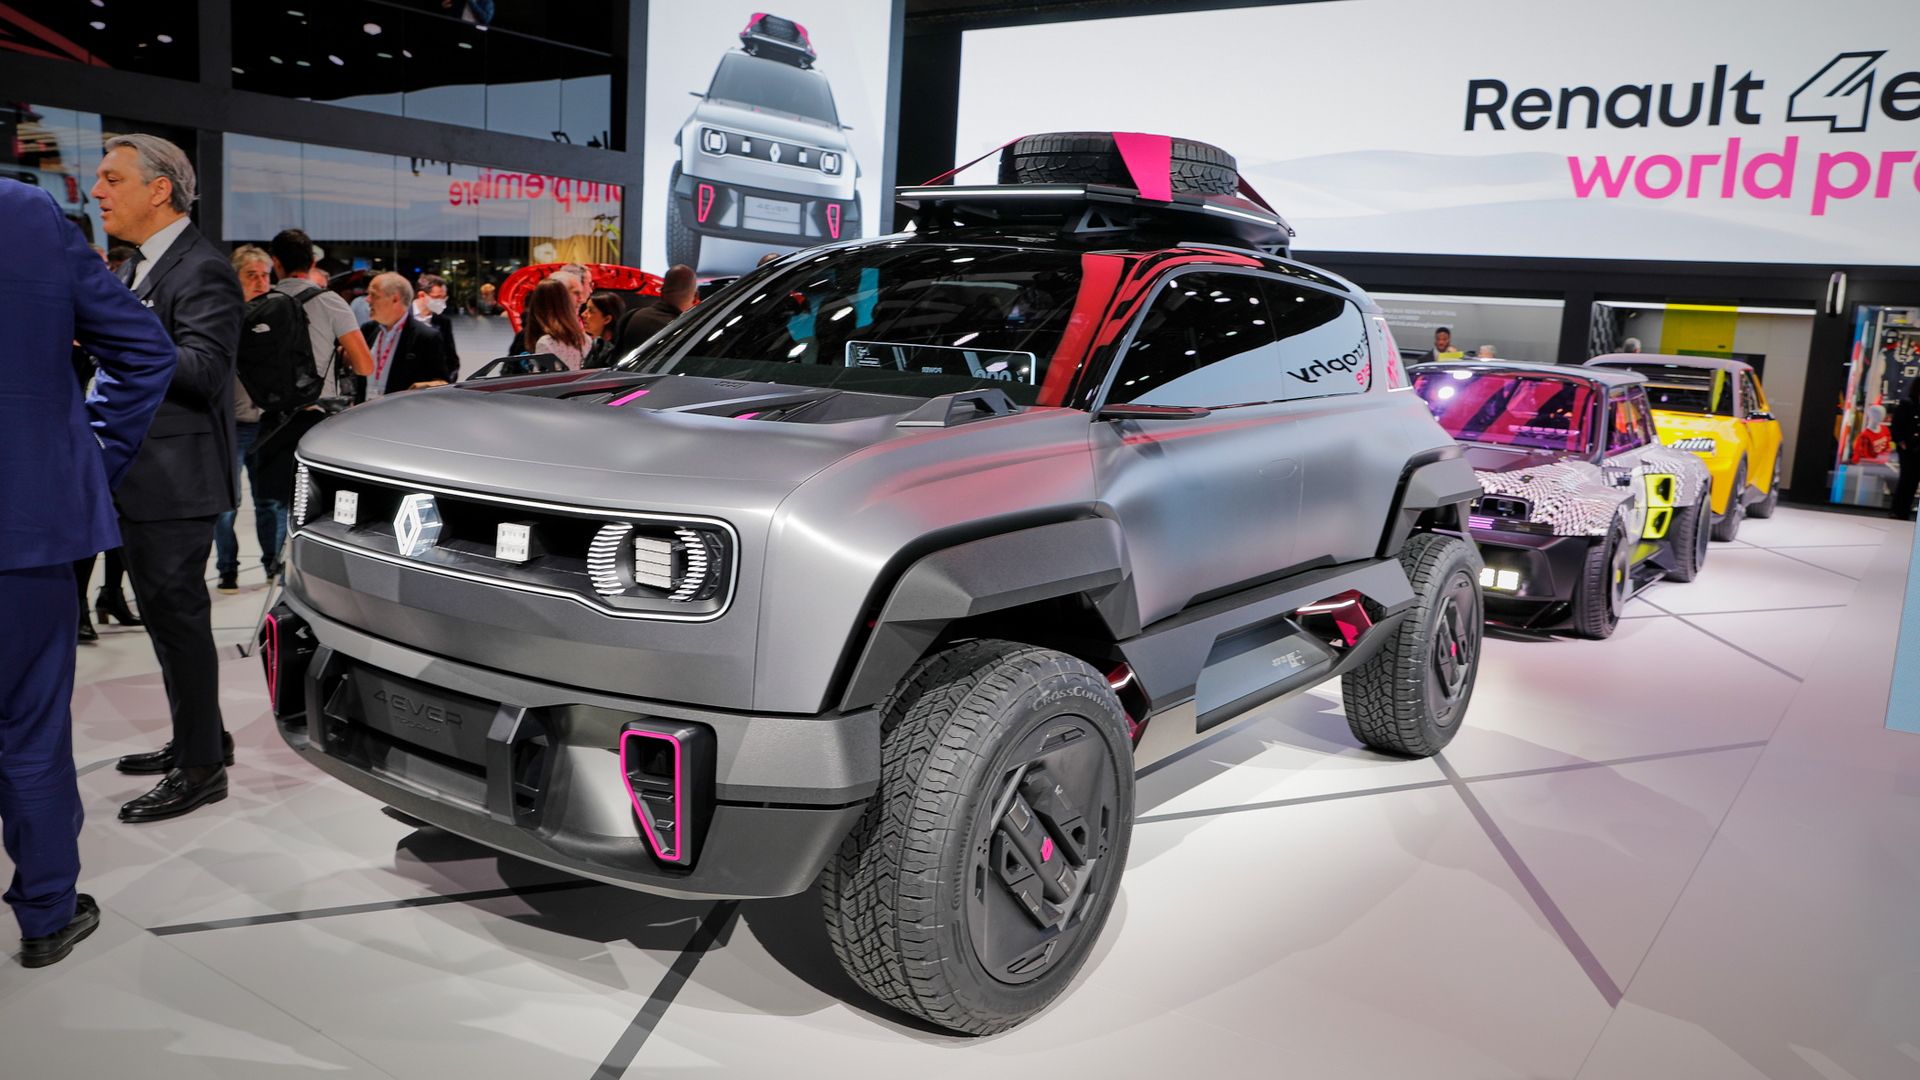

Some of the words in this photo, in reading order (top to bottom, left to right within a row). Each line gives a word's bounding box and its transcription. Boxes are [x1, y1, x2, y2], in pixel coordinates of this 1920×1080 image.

[1465, 64, 1765, 131] Renault
[1567, 135, 1800, 200] world
[1810, 149, 1920, 217] pr
[373, 689, 464, 729] 4EVER
